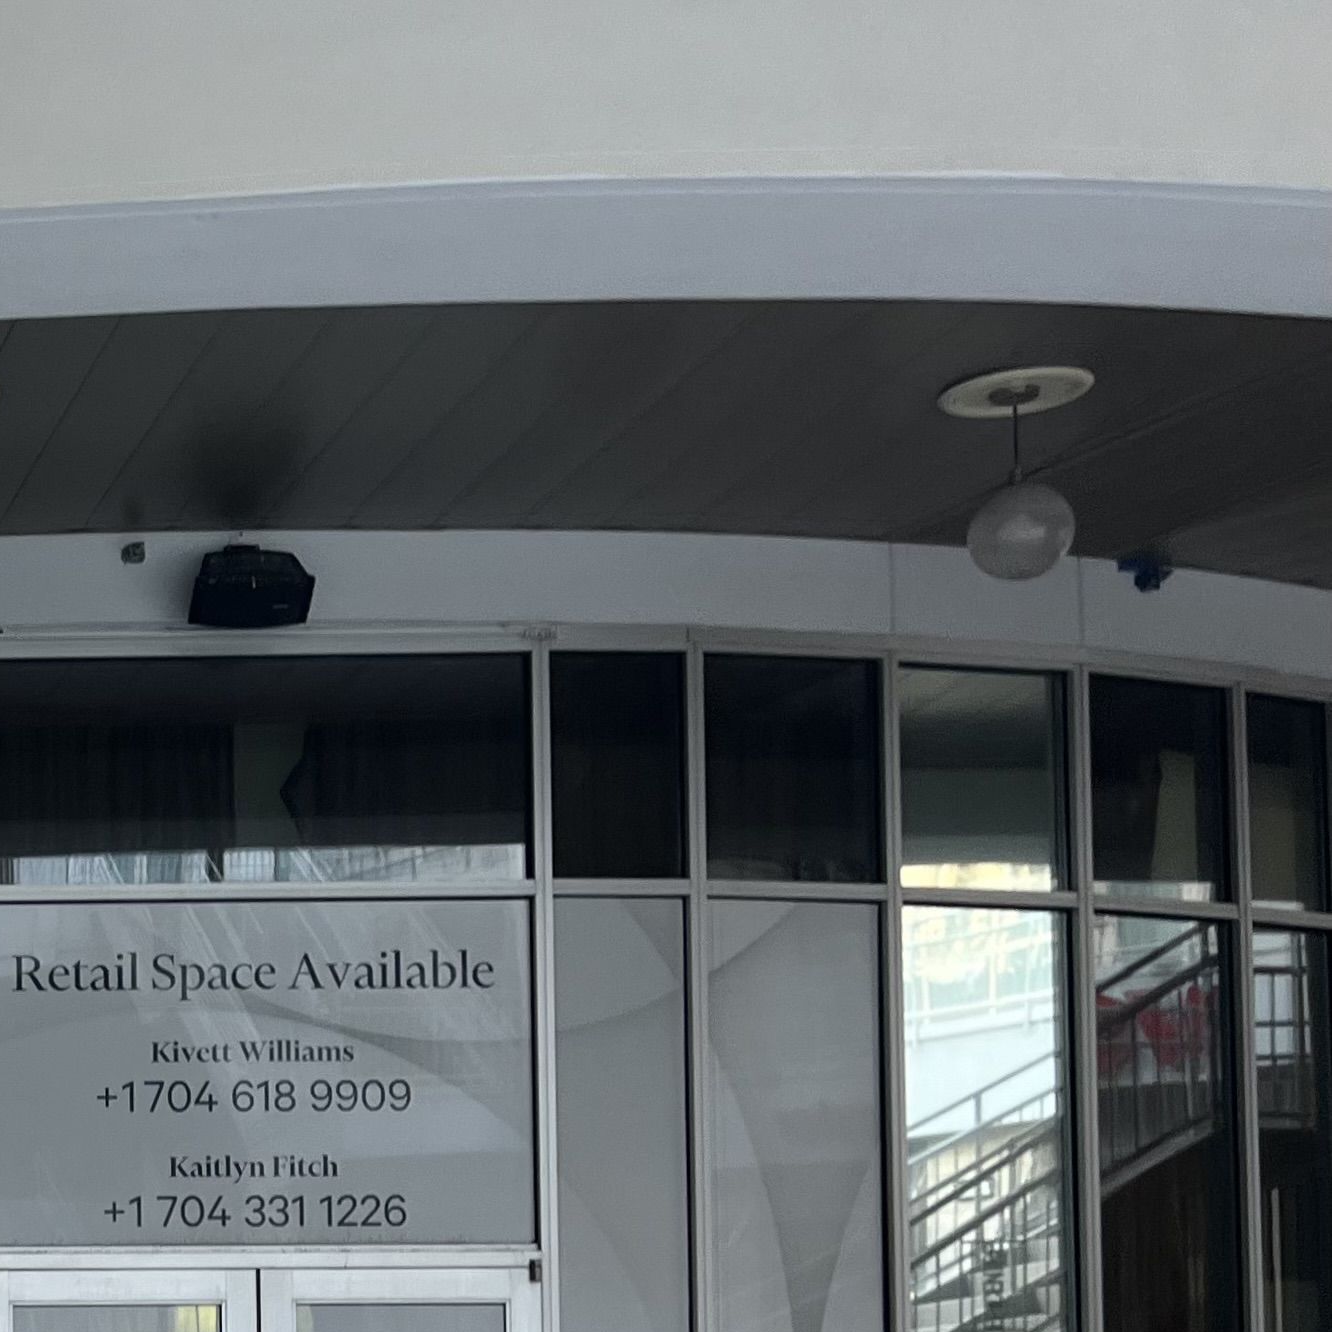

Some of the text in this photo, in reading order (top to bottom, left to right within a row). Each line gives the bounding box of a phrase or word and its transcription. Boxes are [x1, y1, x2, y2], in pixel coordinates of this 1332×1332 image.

[11, 949, 495, 1001] Retail Space Available
[151, 1039, 355, 1063] Kivett Williams
[231, 1079, 297, 1112] 618
[309, 1079, 412, 1112] 9909
[169, 1154, 338, 1183] Kaitlyn Fitch
[103, 1194, 407, 1228] +1 704 331 1226
